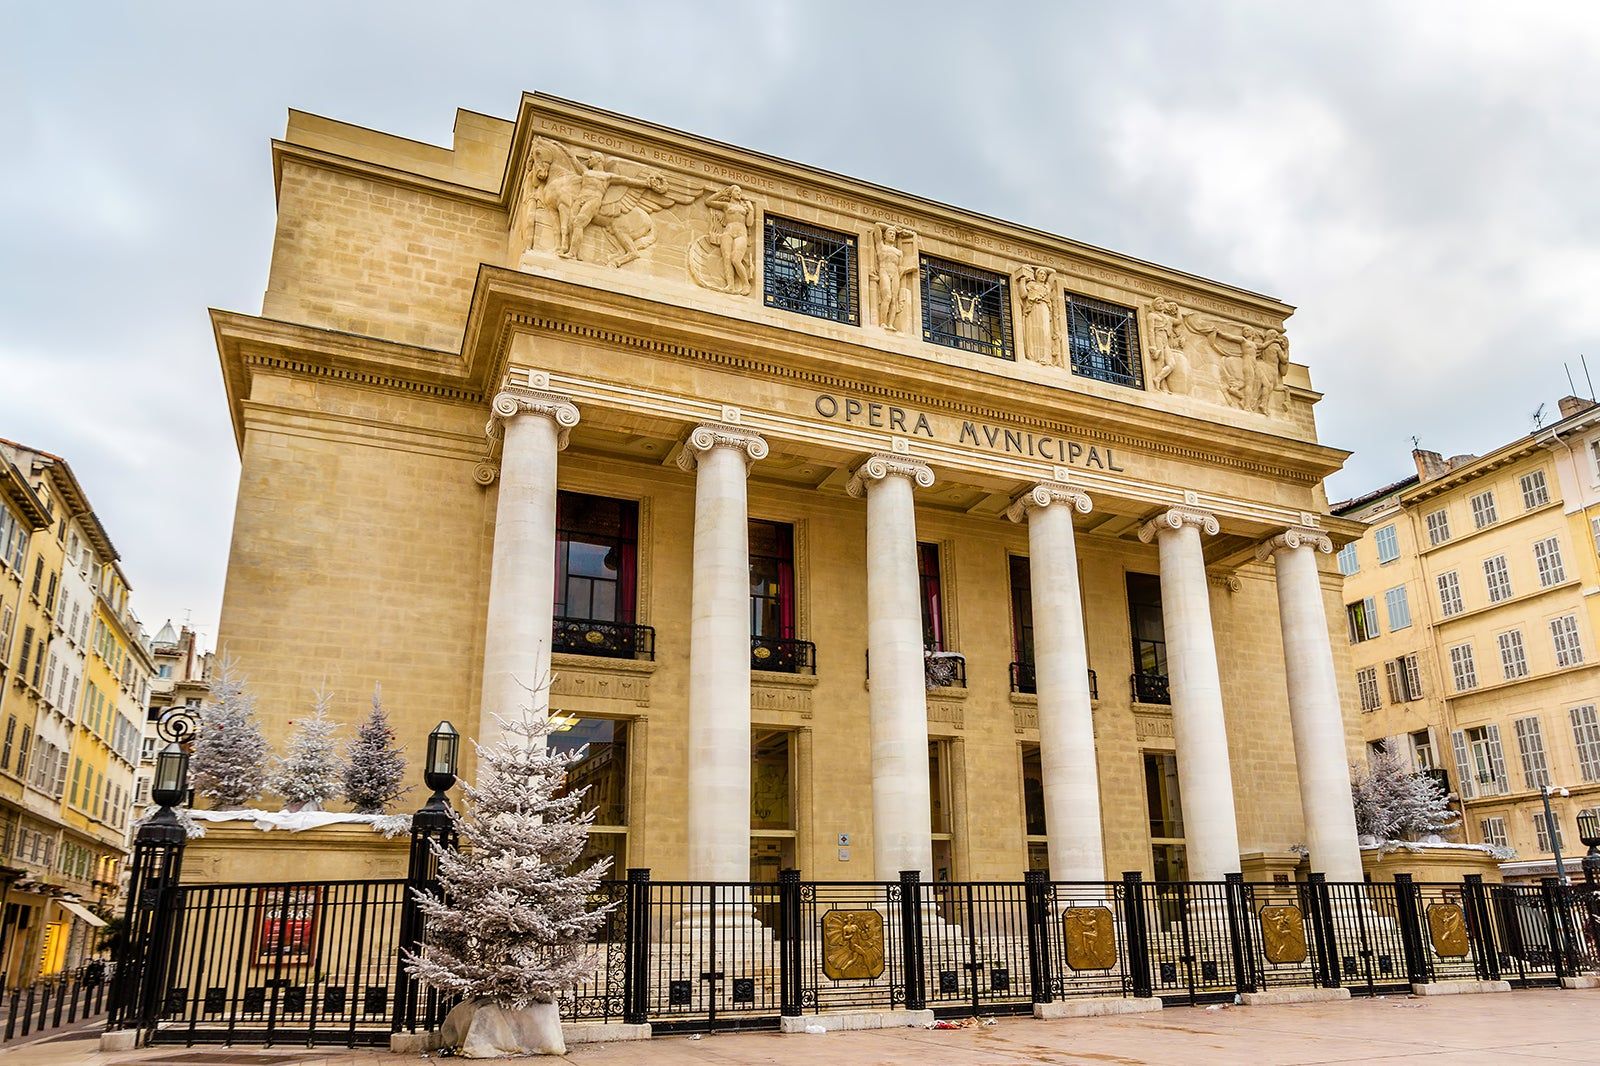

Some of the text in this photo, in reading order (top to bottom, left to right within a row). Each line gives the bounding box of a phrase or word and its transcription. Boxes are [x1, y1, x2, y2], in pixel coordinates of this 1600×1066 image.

[541, 120, 574, 136] L'ART
[631, 144, 646, 156] LA
[653, 150, 696, 168] BEAUTE
[703, 164, 775, 189] D'APHRODITE
[796, 187, 809, 199] LE
[815, 191, 857, 211] RYTHME
[862, 204, 916, 227] D'APOLLON
[933, 226, 993, 248] L'EQUILIBRE
[1000, 241, 1013, 253] DE
[1017, 246, 1055, 265] PALLAS
[1100, 270, 1119, 282] DOIT
[1133, 280, 1173, 298] DIONYSOS
[1191, 296, 1236, 314] MOUVEMENT
[815, 394, 1124, 472] OPERA MVNICIPAL
